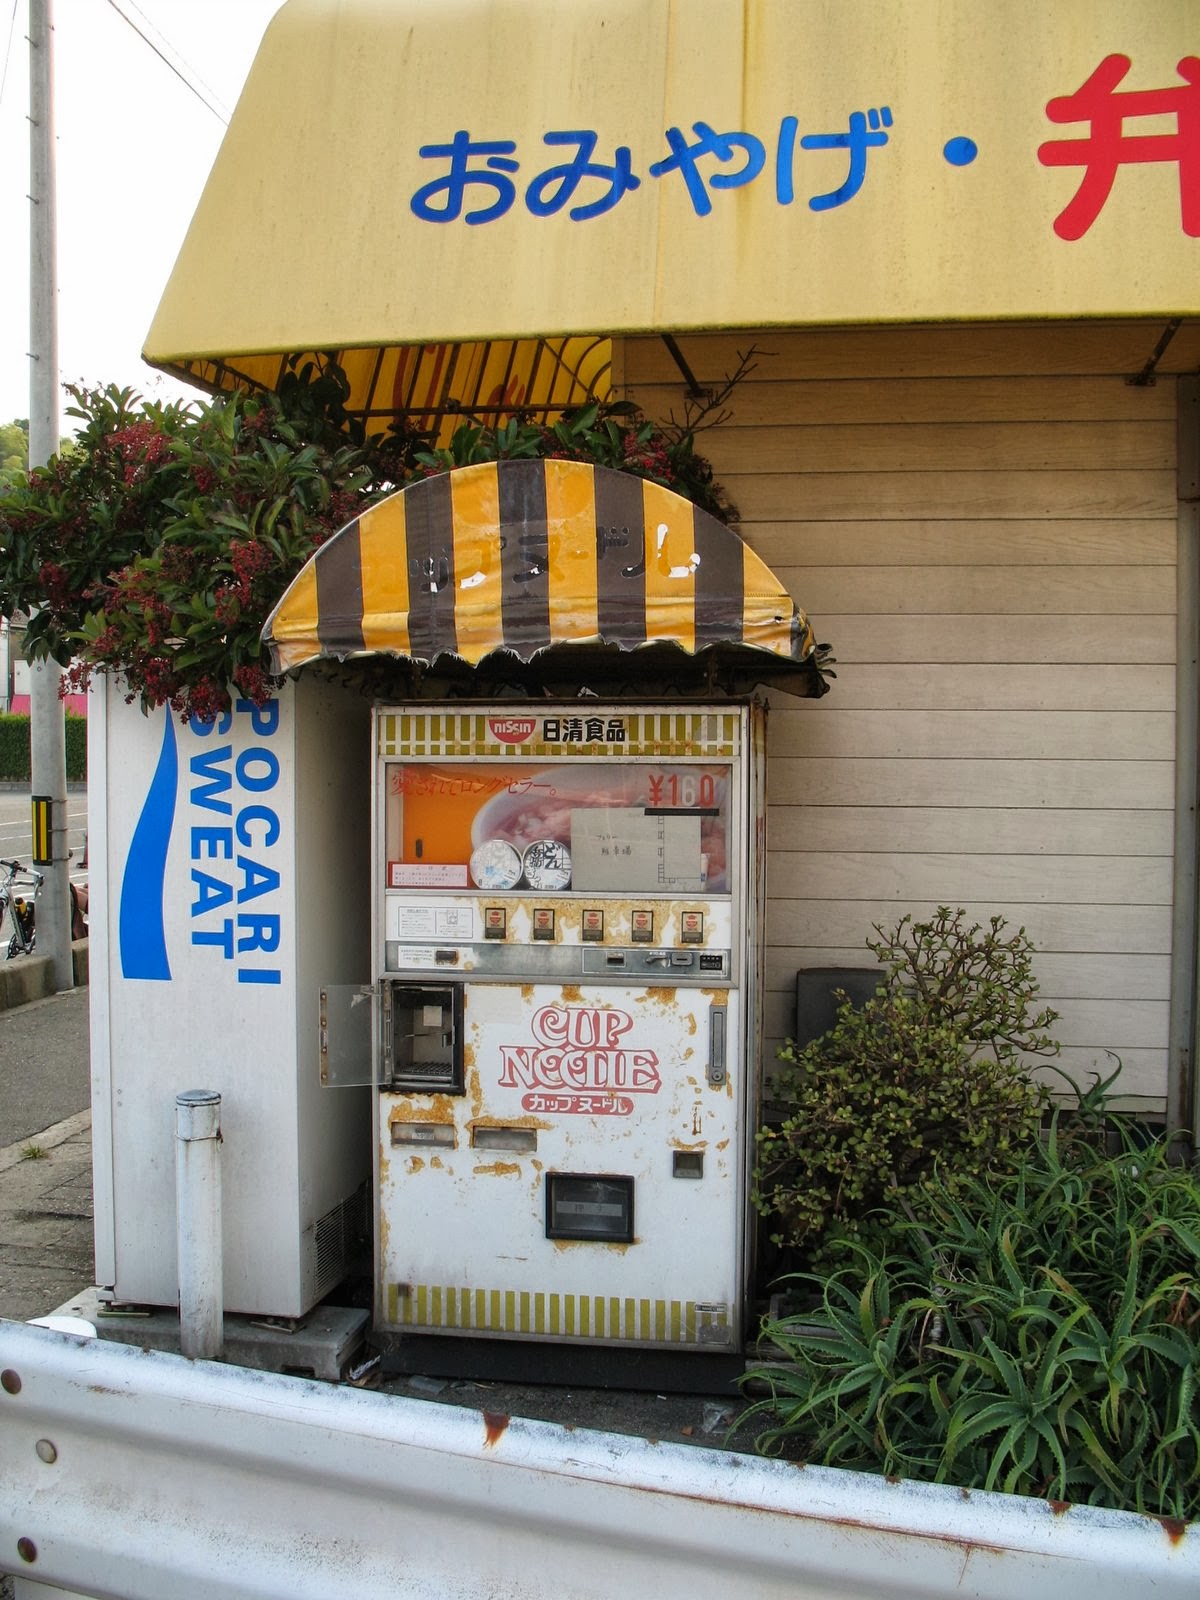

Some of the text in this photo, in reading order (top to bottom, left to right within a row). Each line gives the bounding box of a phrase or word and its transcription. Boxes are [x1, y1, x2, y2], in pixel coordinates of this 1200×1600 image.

[543, 717, 626, 742] 日清食品
[648, 773, 714, 808] ¥160
[188, 705, 234, 959] SWEAT
[236, 697, 281, 984] POCARI
[531, 1004, 634, 1049] CUP
[498, 1045, 662, 1094] NOODLE
[528, 1095, 629, 1114] カップヌードル
